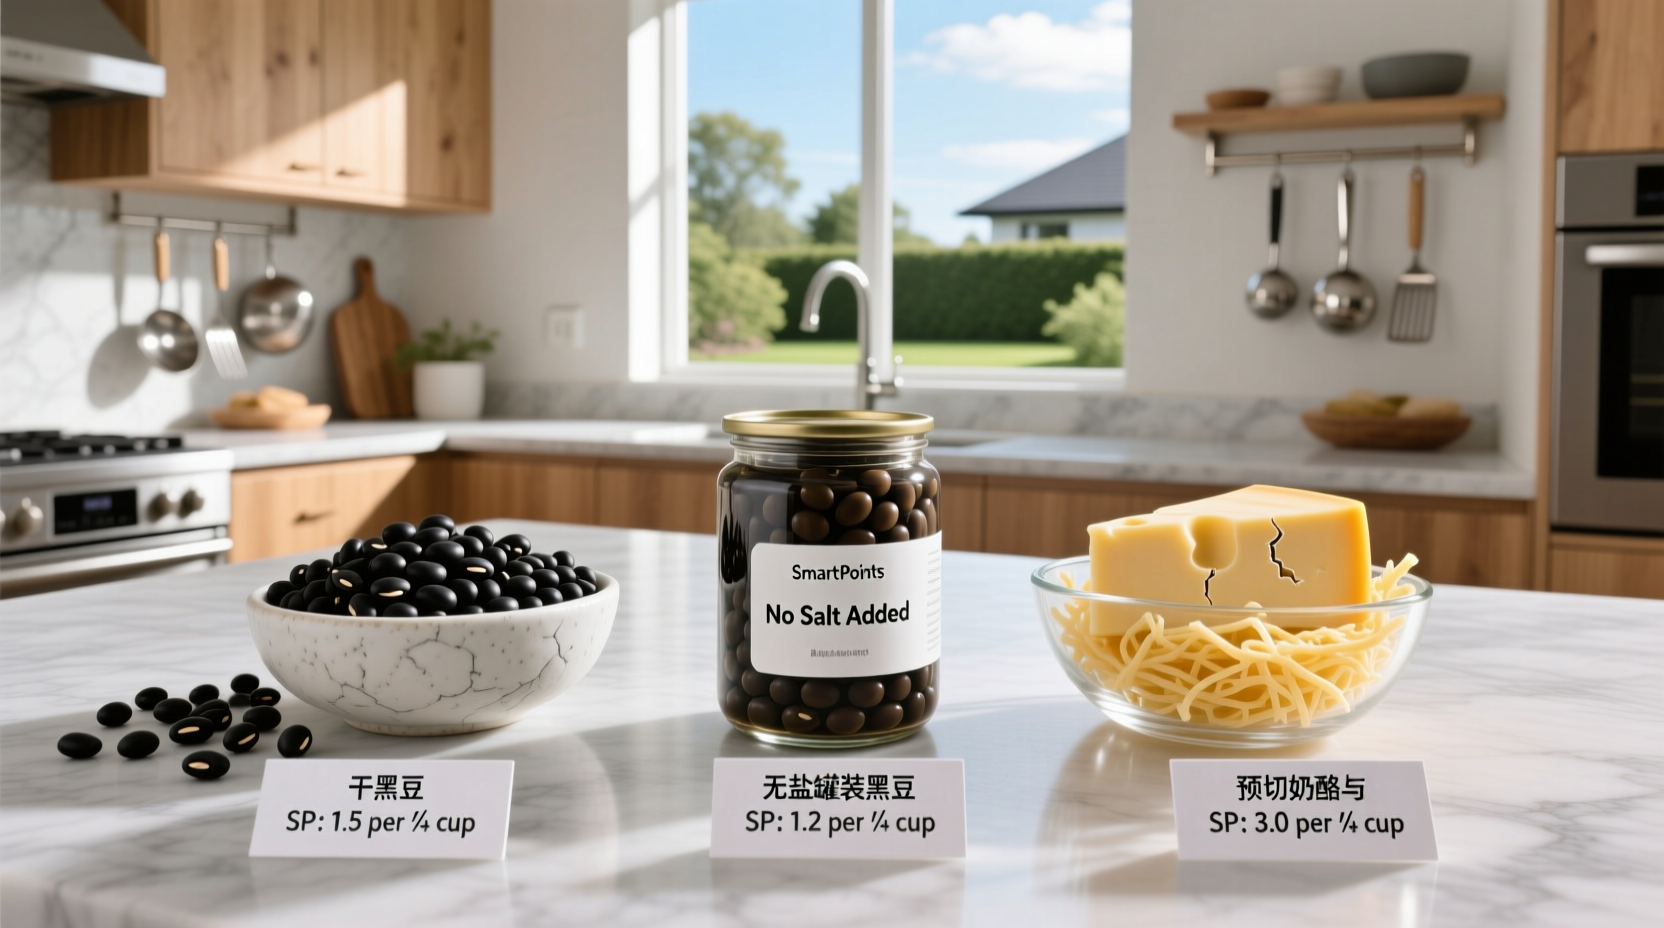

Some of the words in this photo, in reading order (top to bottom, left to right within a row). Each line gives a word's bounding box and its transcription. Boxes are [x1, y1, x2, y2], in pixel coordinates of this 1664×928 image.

[792, 563, 885, 581] SmartPoints
[766, 603, 795, 625] No
[800, 604, 842, 626] Salt
[845, 599, 910, 626] Added
[348, 774, 424, 801] 干黑豆
[762, 772, 916, 802] 无盐罐装黑豆
[1235, 773, 1366, 802] 预切奶酪与
[286, 809, 324, 832] SP:
[332, 810, 363, 832] 1.5
[367, 816, 406, 839] per
[436, 816, 476, 839] cup
[745, 810, 783, 832] SP:
[790, 810, 821, 832] 1.2
[828, 816, 865, 839] per
[895, 816, 936, 839] cup
[1209, 811, 1247, 834] SP:
[1254, 810, 1289, 834] 3.0
[1296, 817, 1333, 840] per
[1364, 817, 1405, 840] cup
